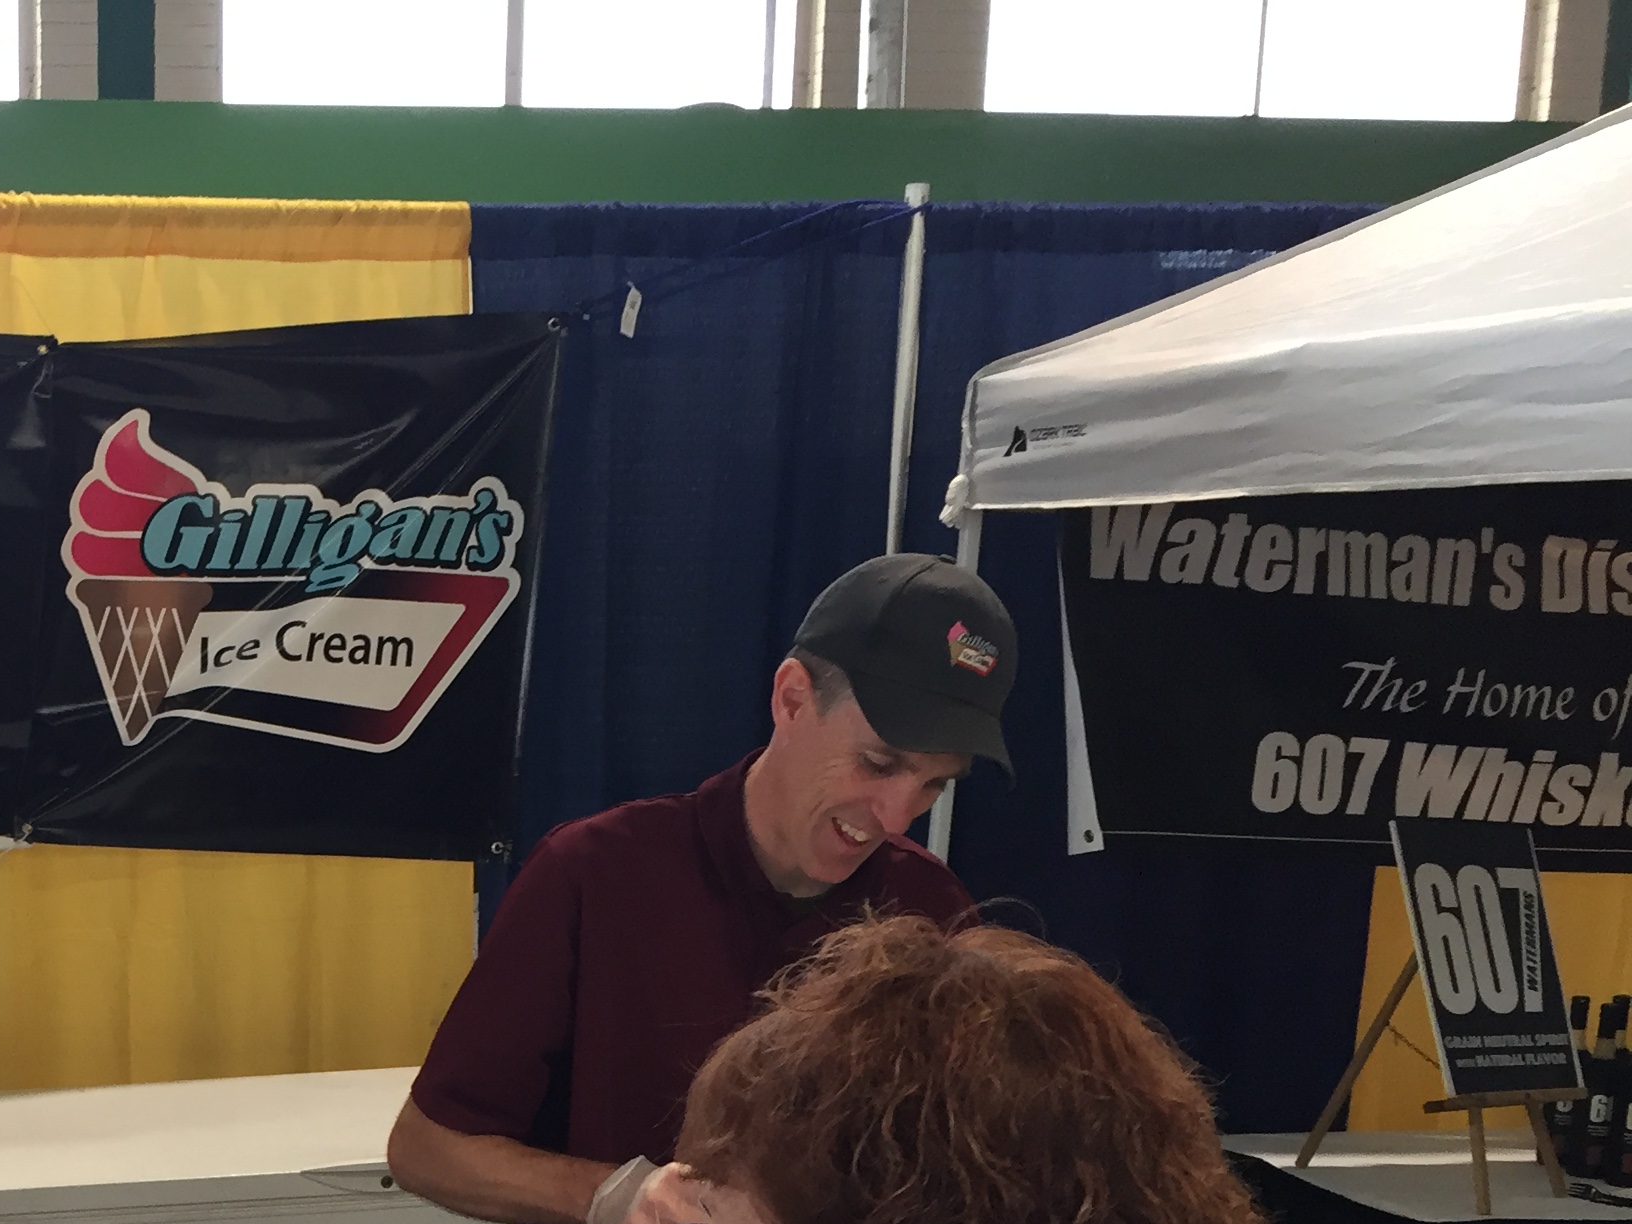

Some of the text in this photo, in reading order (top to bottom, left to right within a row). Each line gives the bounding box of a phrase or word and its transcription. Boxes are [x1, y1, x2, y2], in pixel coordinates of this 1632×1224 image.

[141, 487, 513, 593] Gilligan's
[1090, 502, 1526, 612] Waterman's
[199, 620, 414, 675] Ice Cream
[1341, 656, 1428, 714] The
[1442, 668, 1578, 722] Home
[1251, 731, 1632, 827] 607 Whisk
[1413, 862, 1543, 1015] 607
